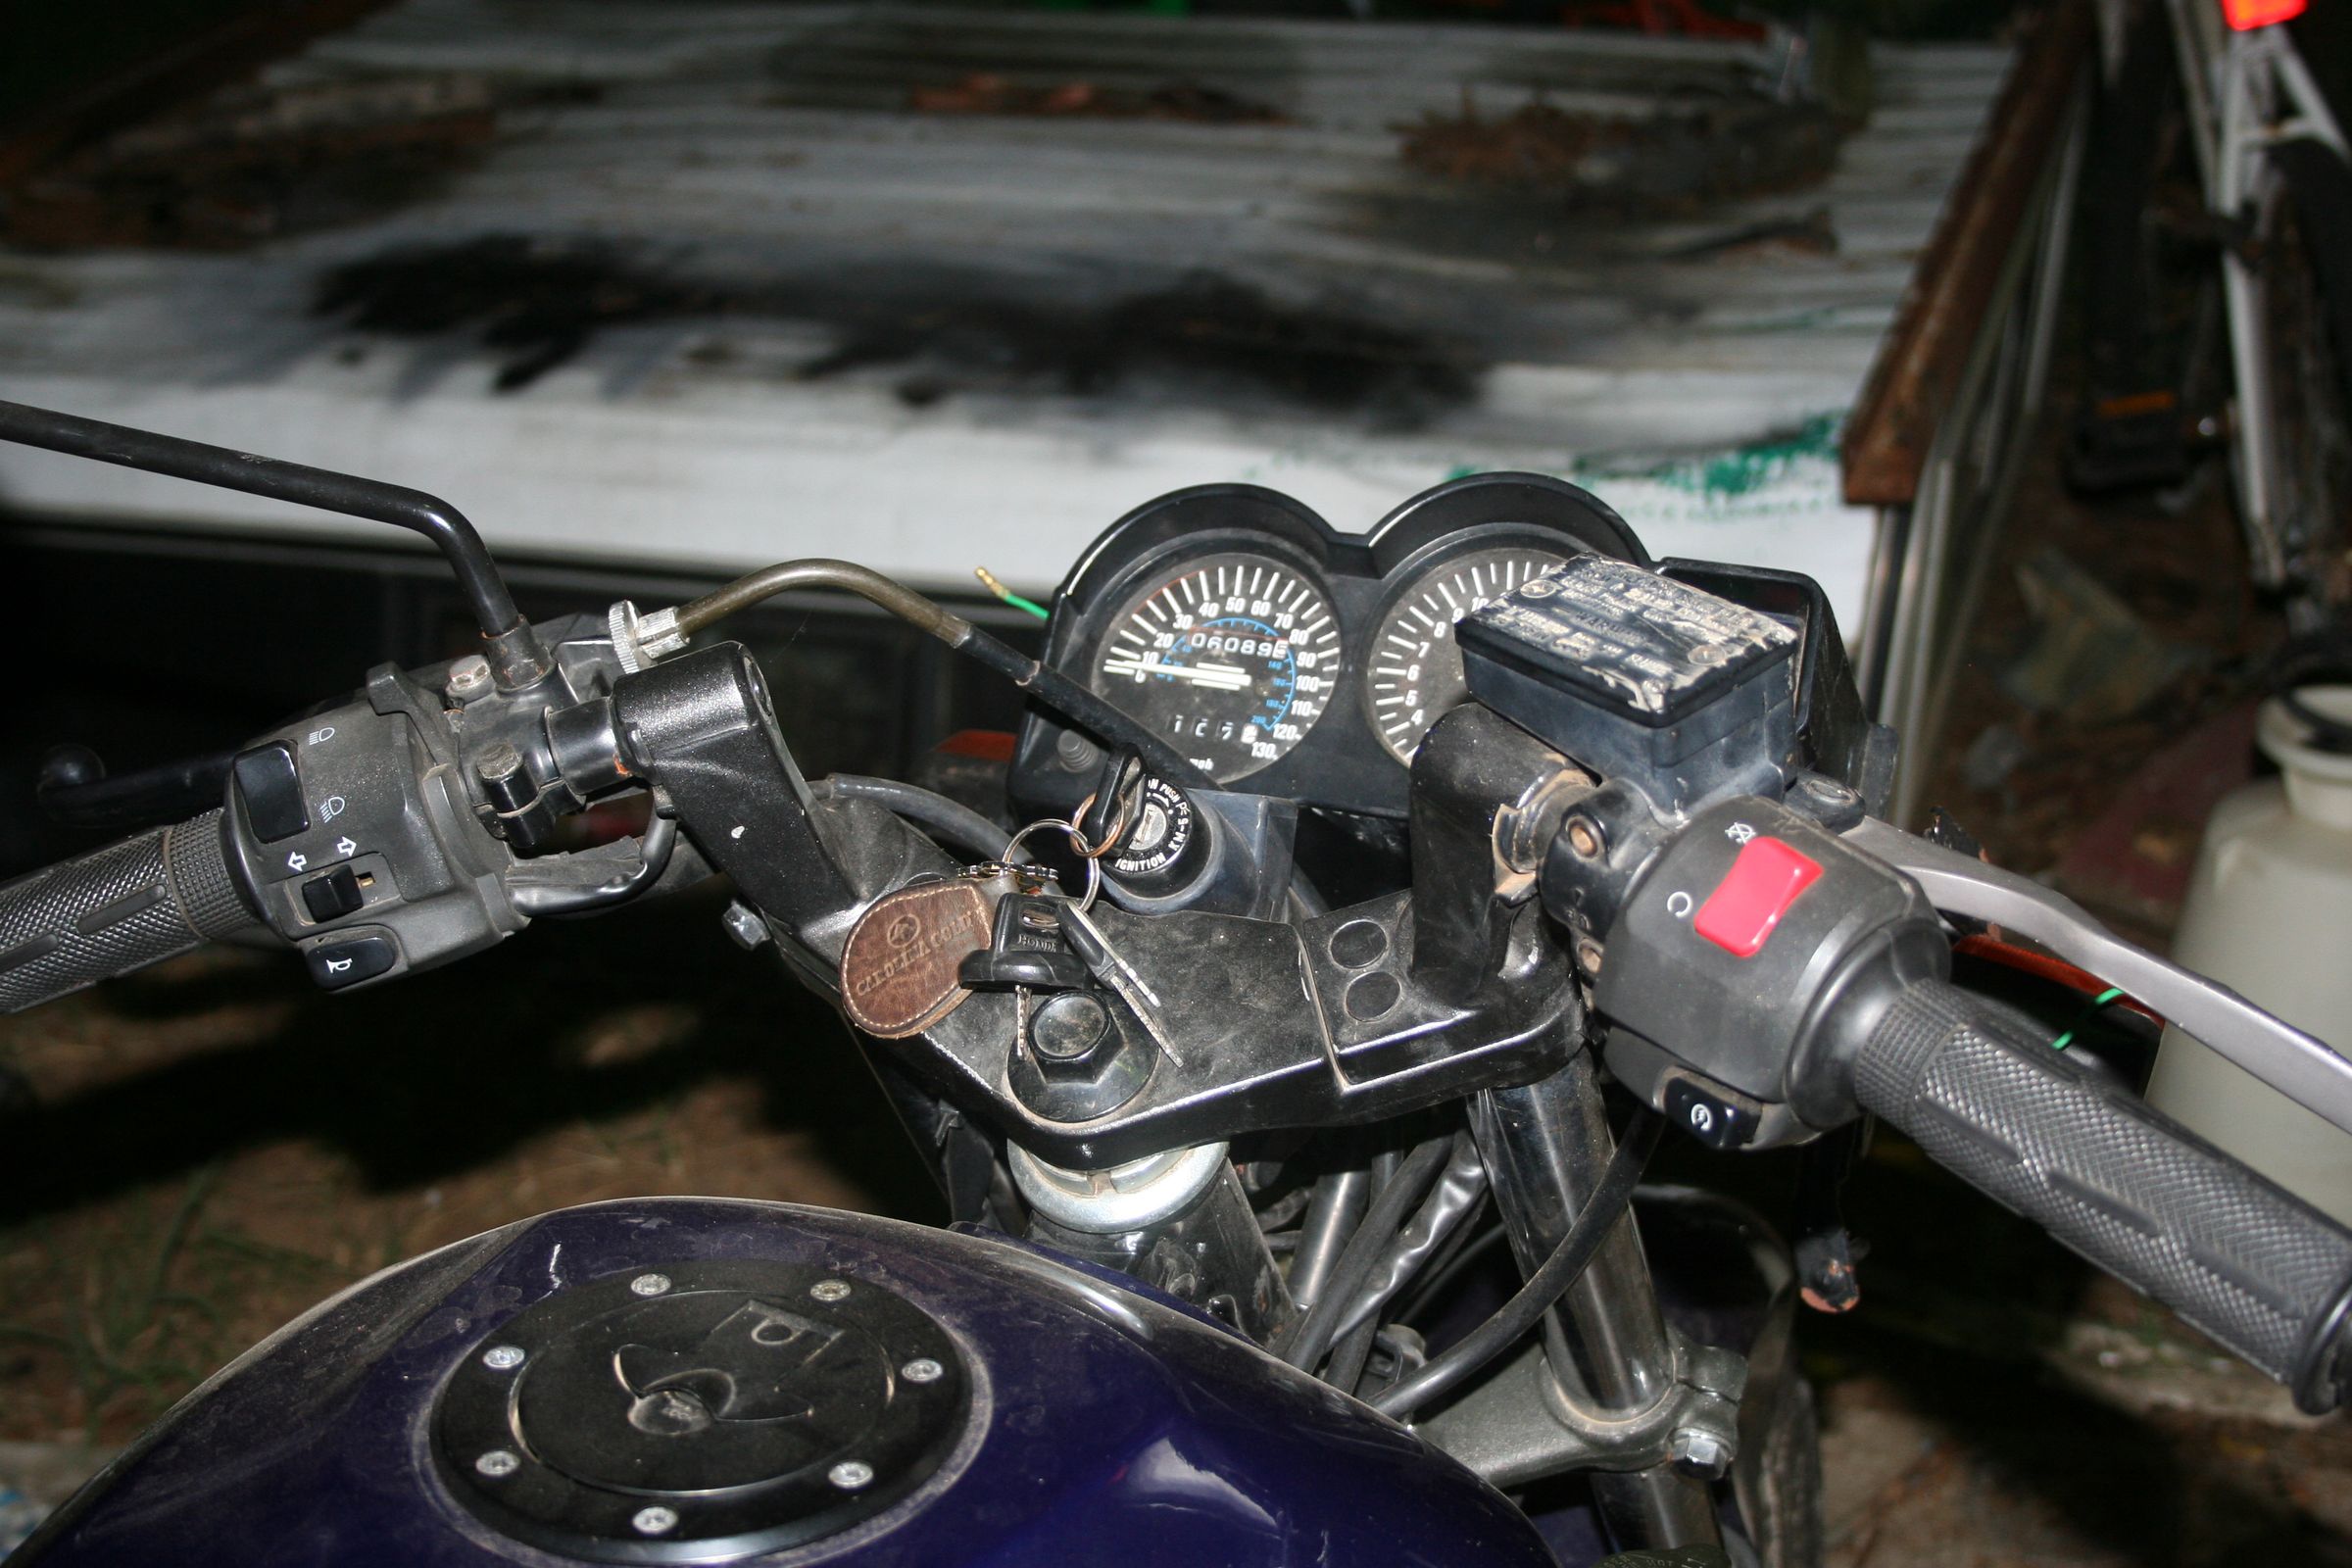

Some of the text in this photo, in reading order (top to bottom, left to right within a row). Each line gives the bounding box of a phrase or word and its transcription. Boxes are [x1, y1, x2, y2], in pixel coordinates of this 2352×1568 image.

[1199, 602, 1219, 618] 40
[1225, 597, 1246, 613] 50
[1250, 600, 1271, 617] 60
[1172, 613, 1194, 630] 30
[1273, 612, 1294, 630] 70
[1451, 608, 1465, 624] 9
[1289, 628, 1309, 646] 80
[1434, 621, 1446, 638] 8
[1153, 632, 1174, 649] 20
[1418, 642, 1430, 658] 7
[1142, 651, 1160, 667] 10
[1296, 651, 1317, 668] 90
[1407, 664, 1420, 681] 6
[1295, 674, 1320, 693] 100
[1404, 689, 1418, 707] 5
[1291, 699, 1312, 716] 110
[1411, 710, 1423, 725] 4
[1273, 723, 1298, 740] 120
[1251, 741, 1276, 759] 130
[1159, 783, 1181, 804] PUSH
[1114, 852, 1167, 872] IGNITION
